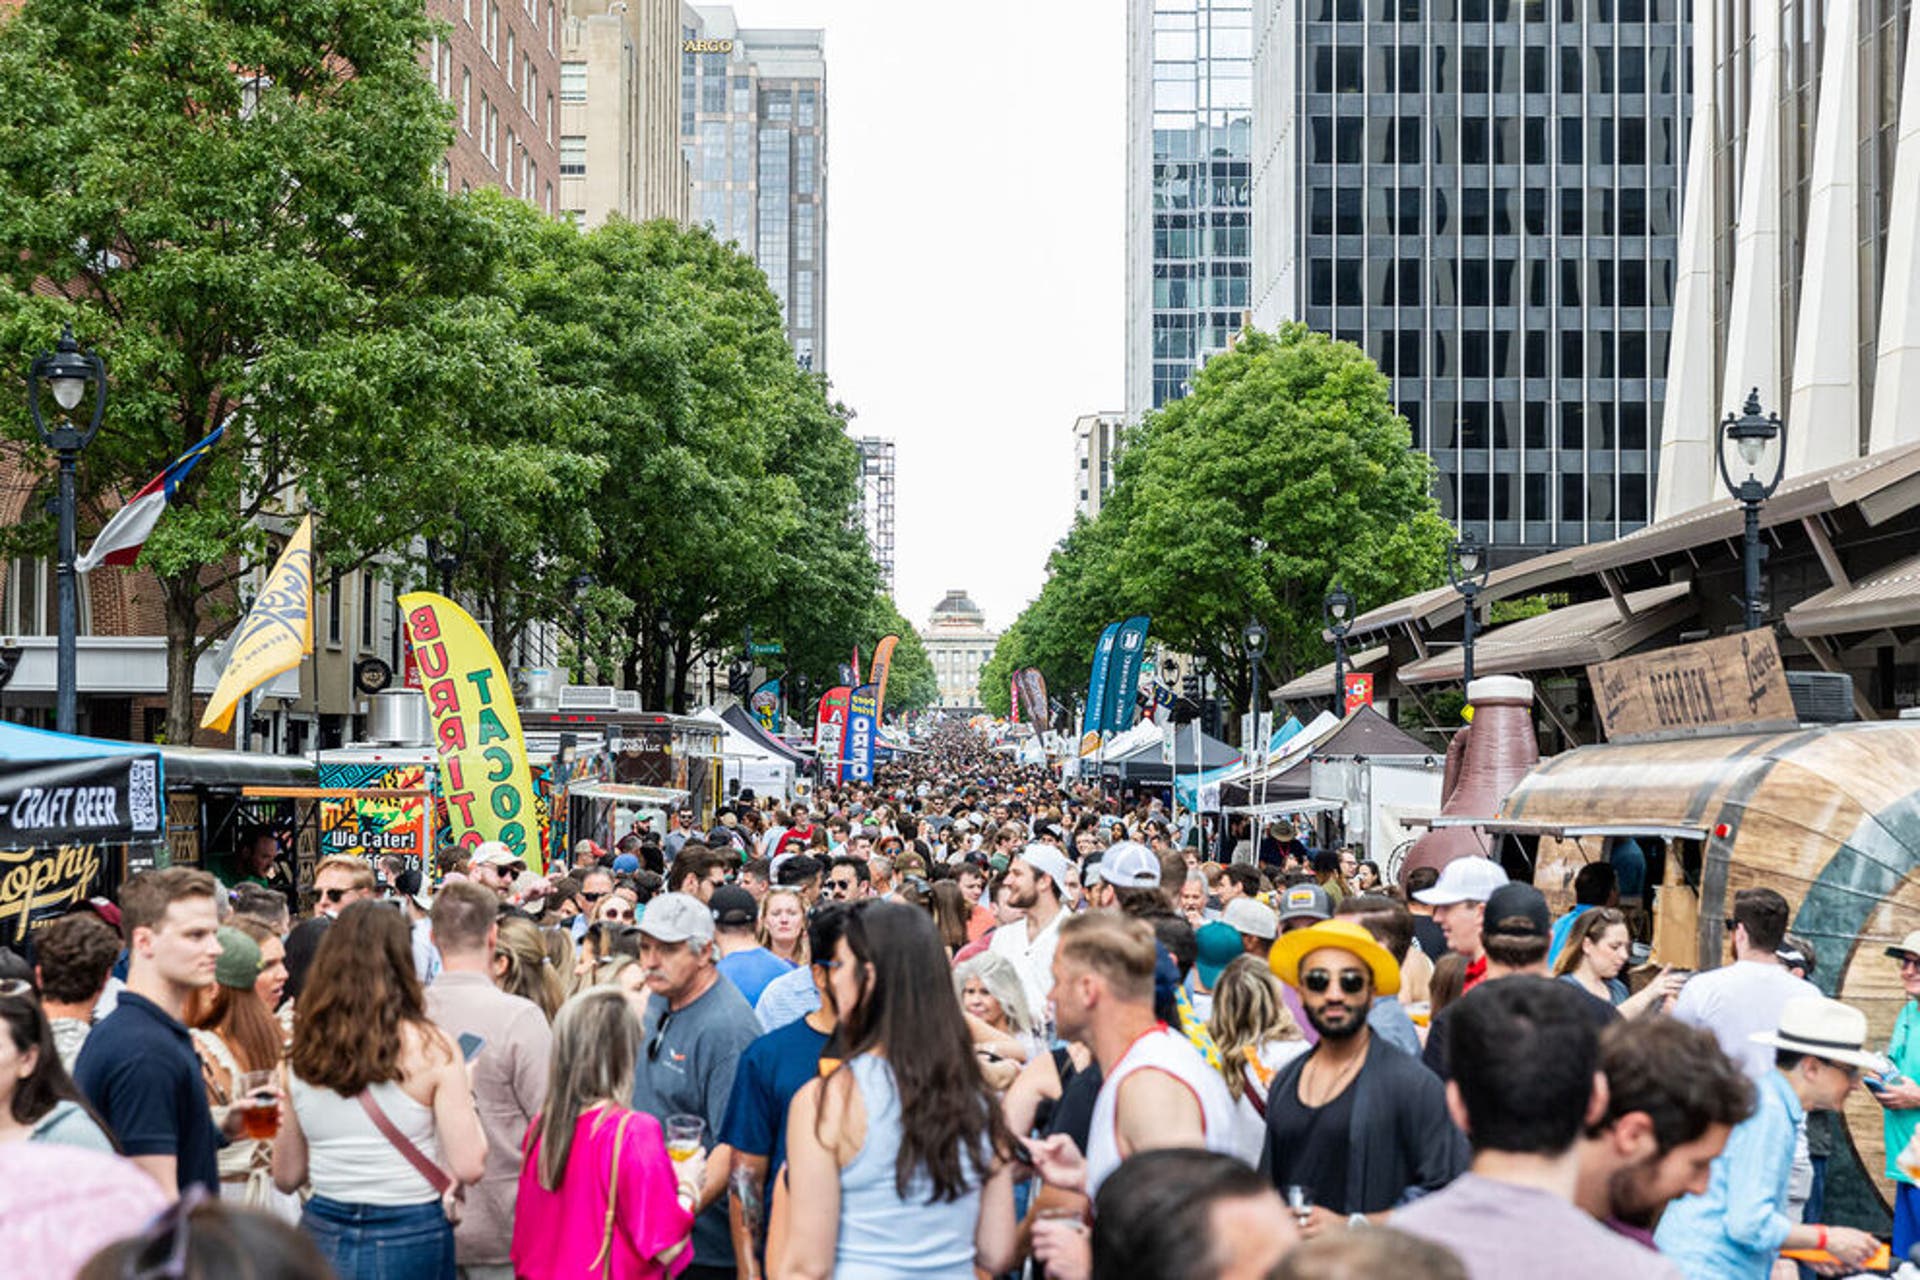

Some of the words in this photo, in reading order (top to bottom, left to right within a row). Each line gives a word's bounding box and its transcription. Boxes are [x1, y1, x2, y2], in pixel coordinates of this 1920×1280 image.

[682, 40, 733, 54] ARGO
[11, 787, 74, 829] CRAFT
[73, 786, 120, 827] BEER
[332, 831, 358, 847] We
[362, 831, 415, 848] Cater!
